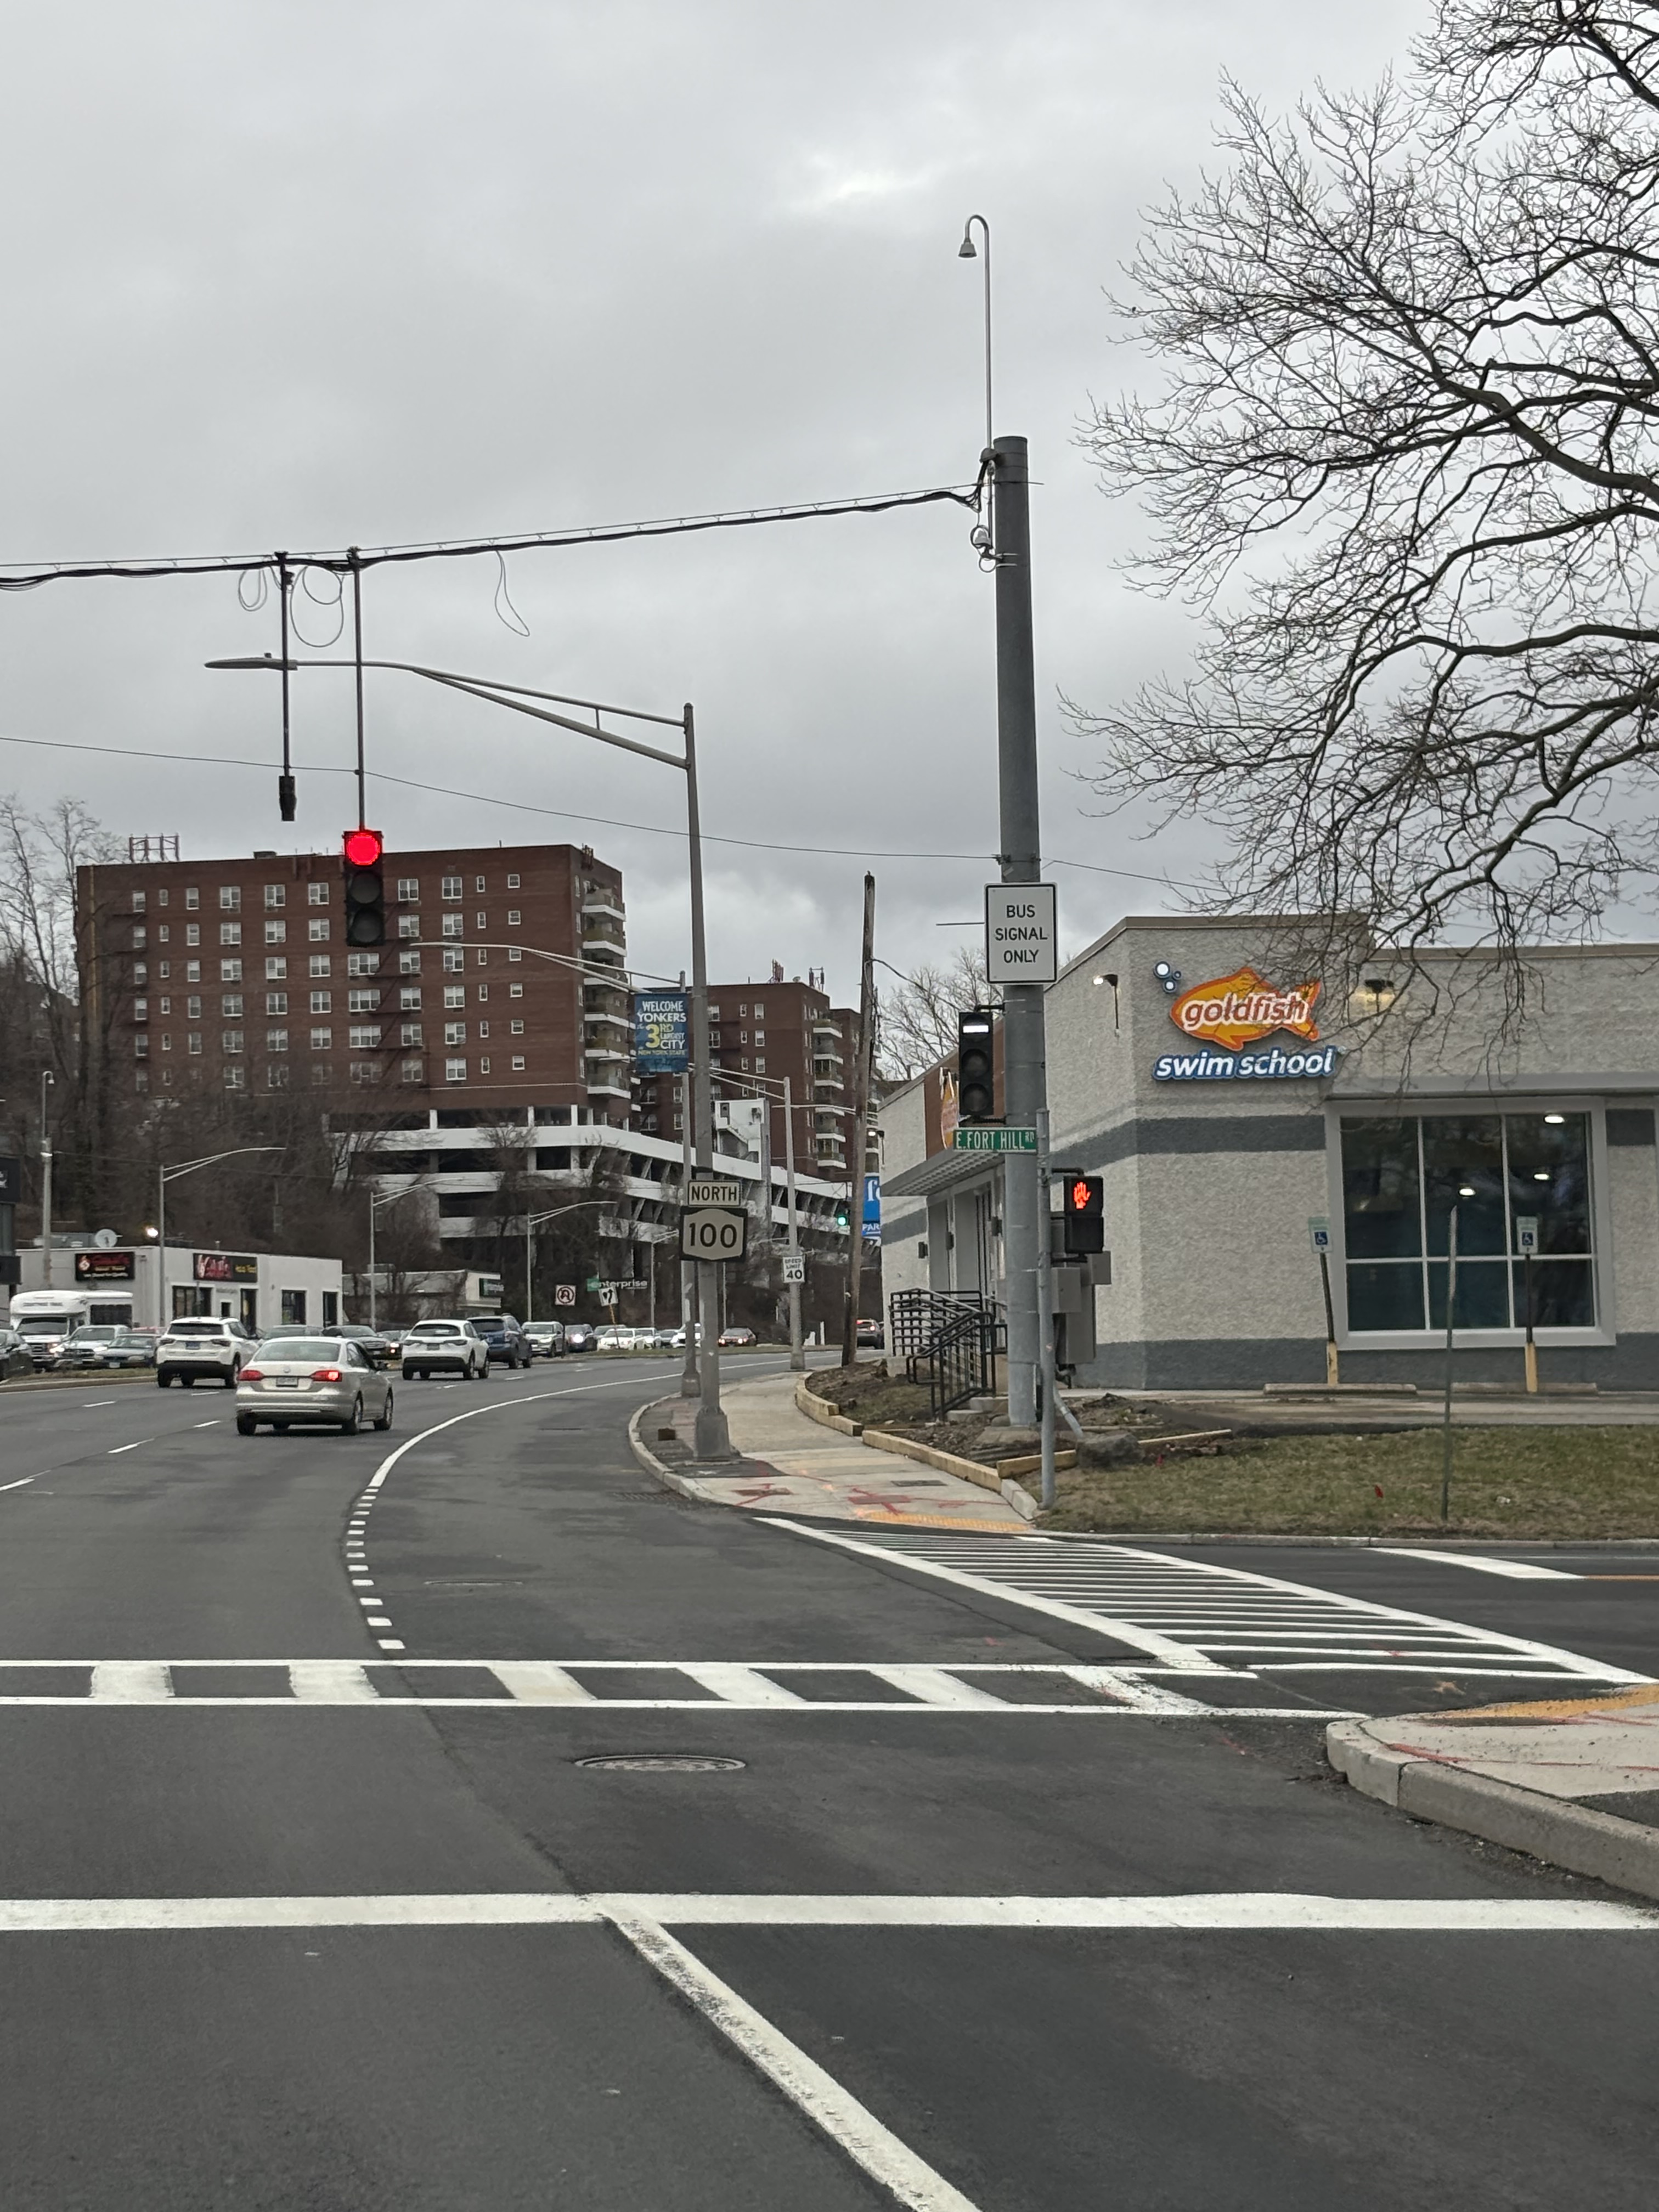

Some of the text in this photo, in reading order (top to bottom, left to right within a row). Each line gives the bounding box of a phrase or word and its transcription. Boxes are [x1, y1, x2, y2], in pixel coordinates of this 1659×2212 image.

[1006, 904, 1035, 918] BUS
[995, 927, 1048, 941] SIGNAL
[1003, 949, 1039, 963] ONLY
[642, 1001, 684, 1012] WELCOME
[1183, 994, 1306, 1028] goldfish
[637, 1012, 687, 1023] YONKERS
[660, 1040, 685, 1049] CITY
[1156, 1048, 1334, 1077] swim school
[1000, 1131, 1025, 1149] HILL
[1025, 1132, 1035, 1143] RD
[691, 1186, 737, 1201] NORTH
[689, 1222, 737, 1248] 100
[786, 1269, 803, 1279] 40
[589, 1280, 647, 1289] enterprise
